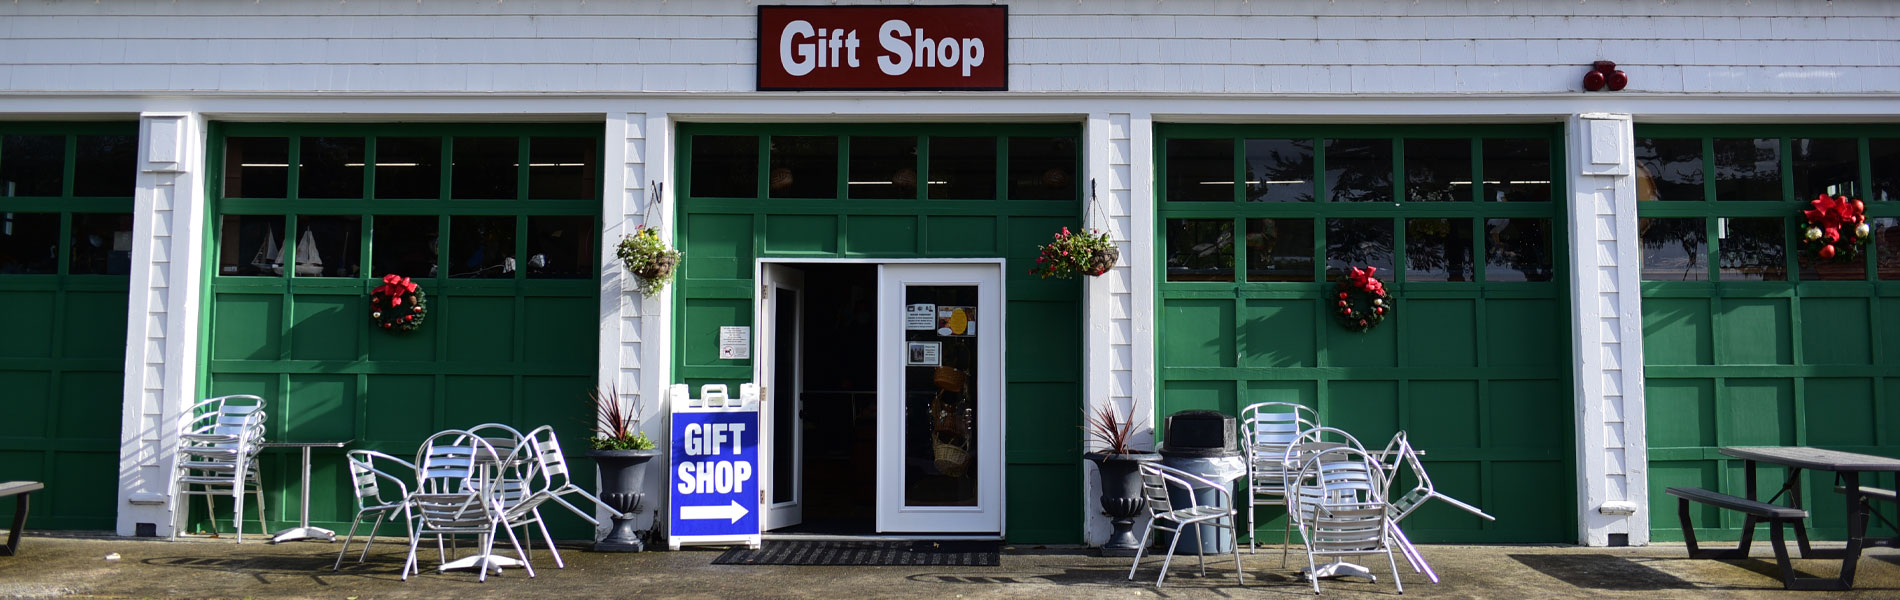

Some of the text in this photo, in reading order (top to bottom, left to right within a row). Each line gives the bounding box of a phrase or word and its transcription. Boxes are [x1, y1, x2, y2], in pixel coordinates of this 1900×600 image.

[780, 19, 985, 77] Gift Shop
[684, 423, 746, 456] GIFT
[677, 460, 752, 495] SHOP
